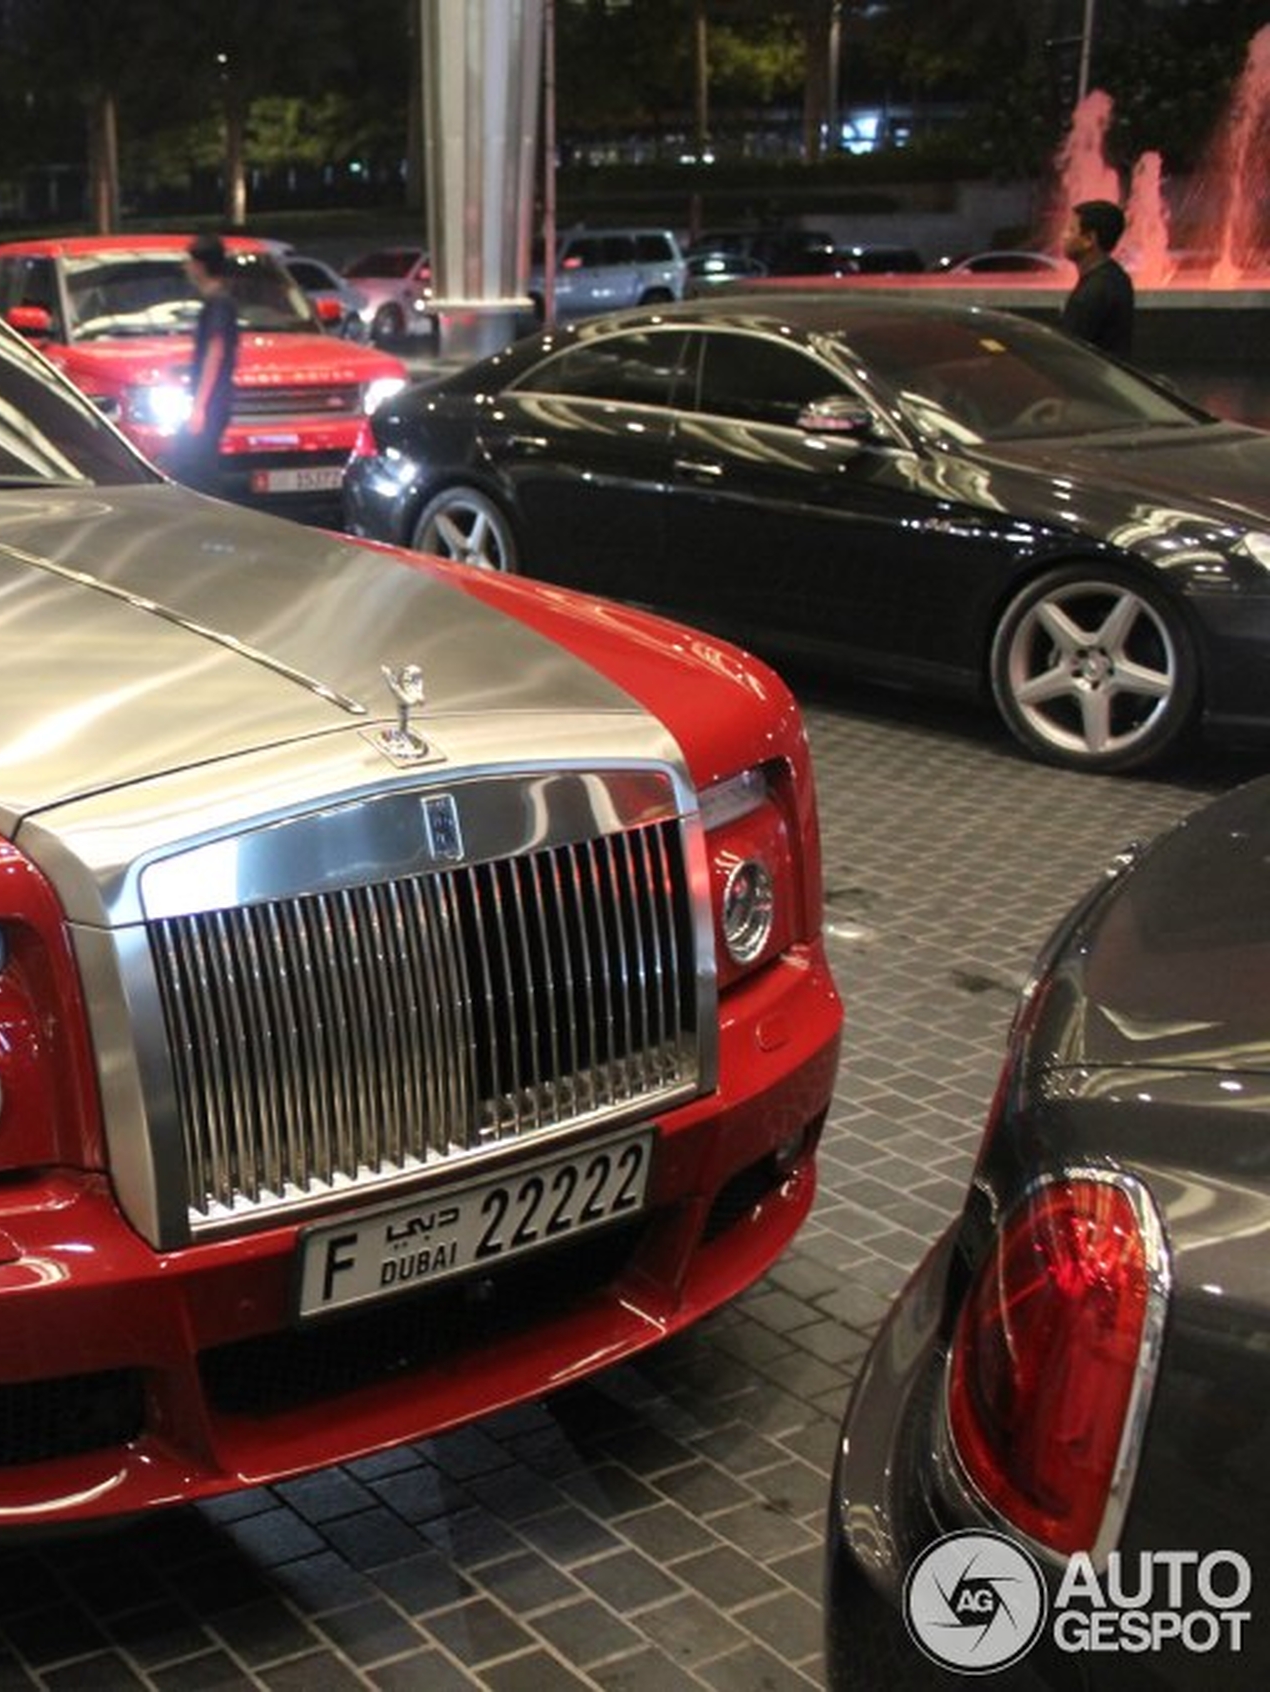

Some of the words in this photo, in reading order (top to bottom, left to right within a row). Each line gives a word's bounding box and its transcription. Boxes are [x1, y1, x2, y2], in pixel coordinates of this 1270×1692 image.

[474, 1144, 644, 1259] 22222
[322, 1234, 358, 1299] F
[380, 1242, 457, 1287] DUBAI
